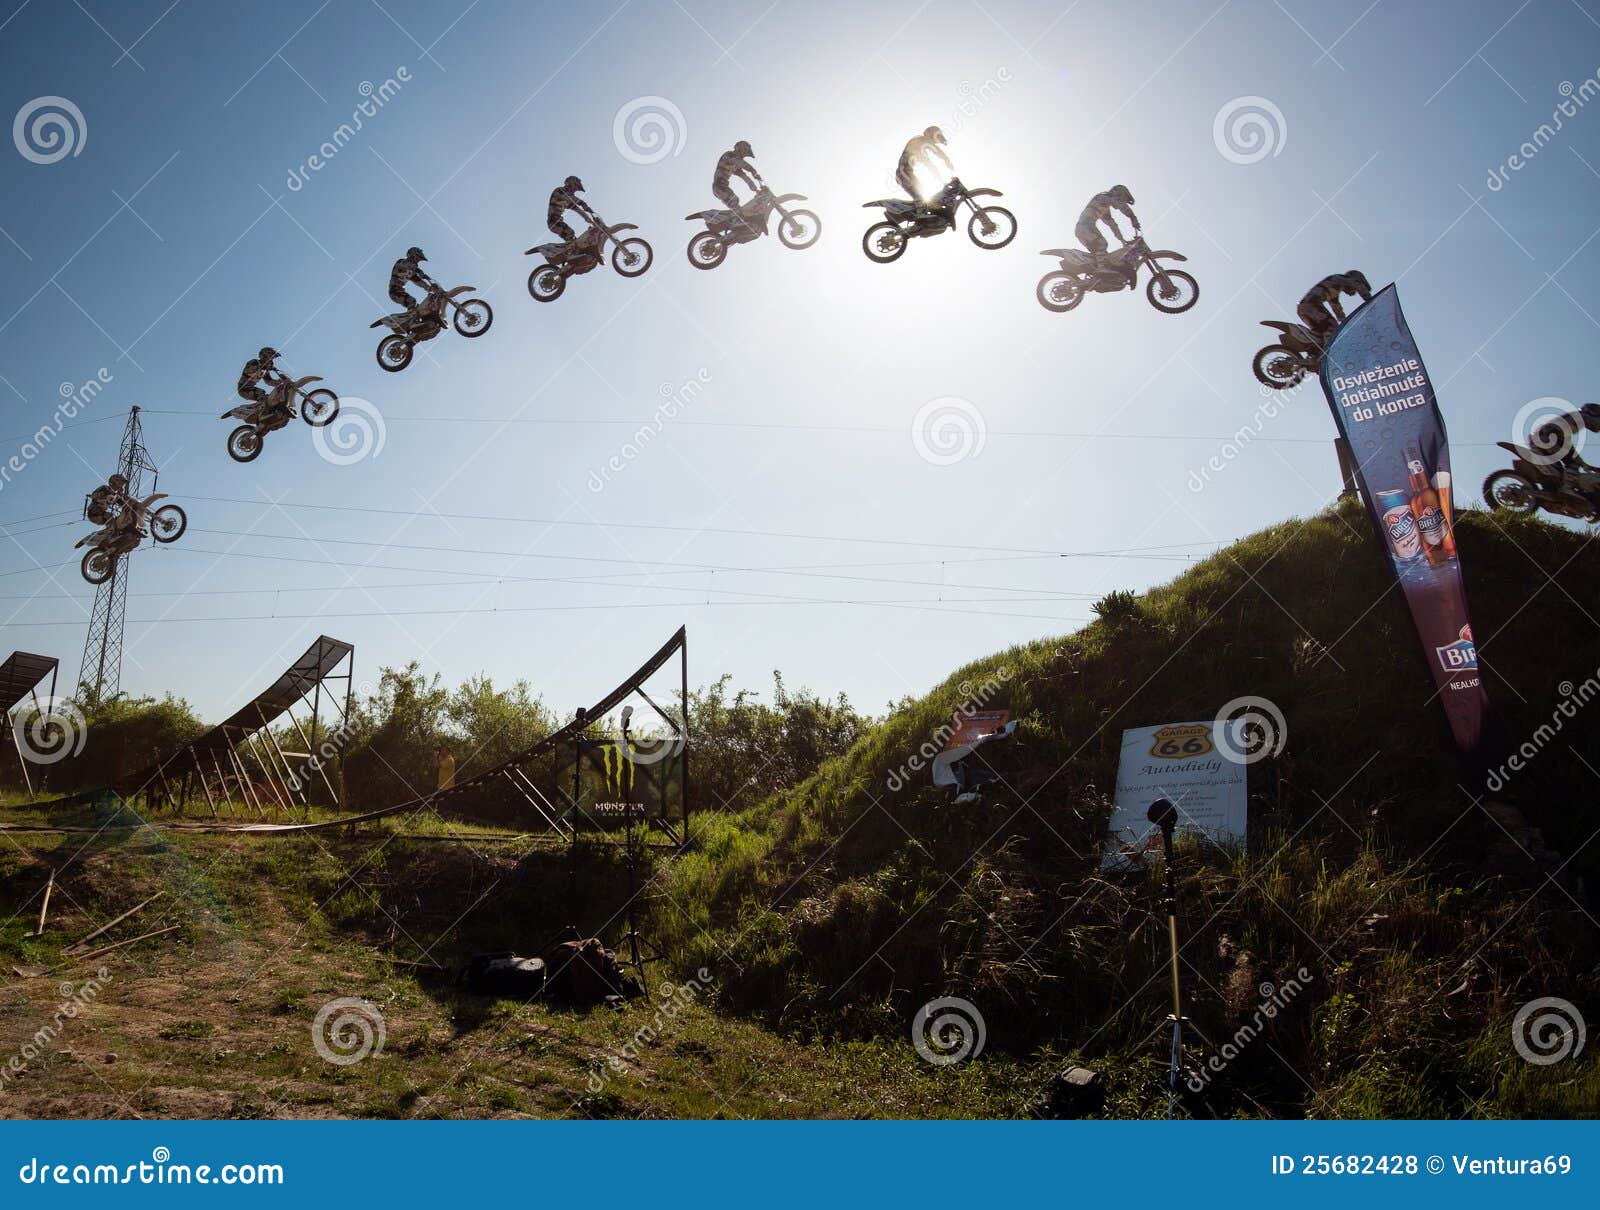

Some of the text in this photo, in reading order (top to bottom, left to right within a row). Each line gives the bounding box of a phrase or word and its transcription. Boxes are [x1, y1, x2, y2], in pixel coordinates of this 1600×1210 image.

[1333, 358, 1419, 392] Osvieženie
[1340, 372, 1426, 408] dotiahnuté
[1353, 393, 1426, 422] do konca
[1161, 727, 1204, 737] GARAGE
[1160, 738, 1202, 755] 66
[1137, 760, 1222, 776] Autodiely
[595, 801, 645, 812] MONSER
